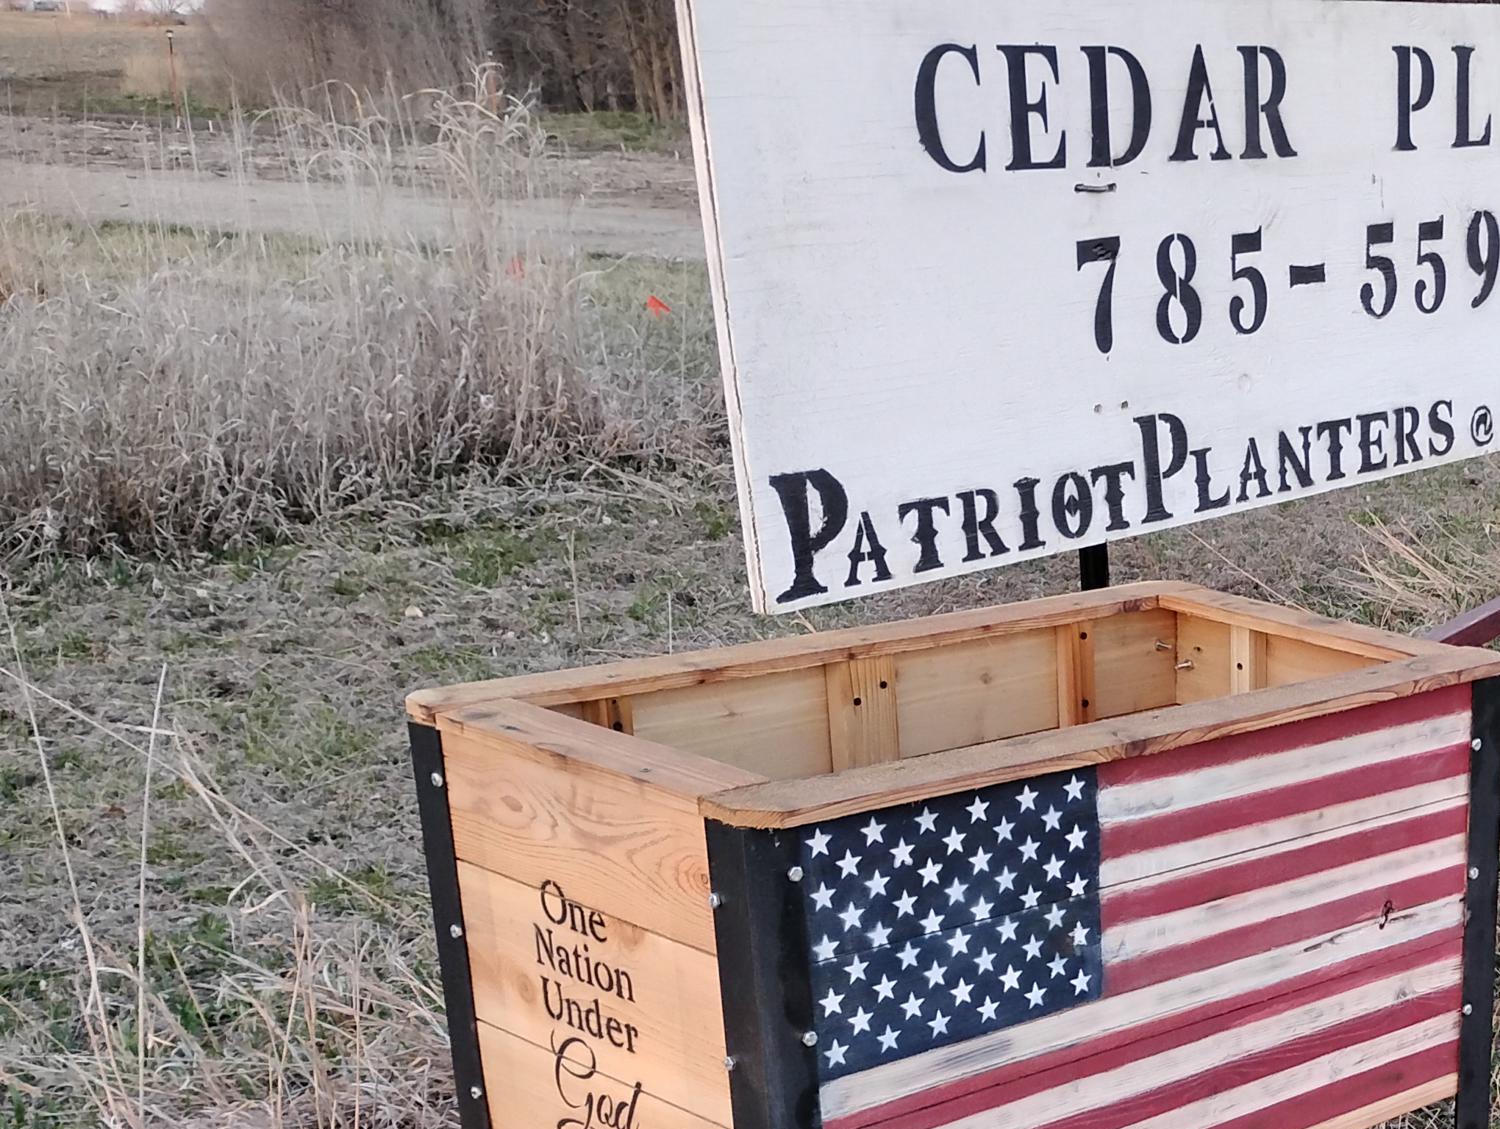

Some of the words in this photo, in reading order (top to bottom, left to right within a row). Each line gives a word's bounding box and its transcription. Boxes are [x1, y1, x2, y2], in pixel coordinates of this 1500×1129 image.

[914, 43, 1298, 173] CEDAR
[540, 879, 608, 943] One
[533, 922, 636, 1003] Nation
[540, 975, 639, 1054] Under
